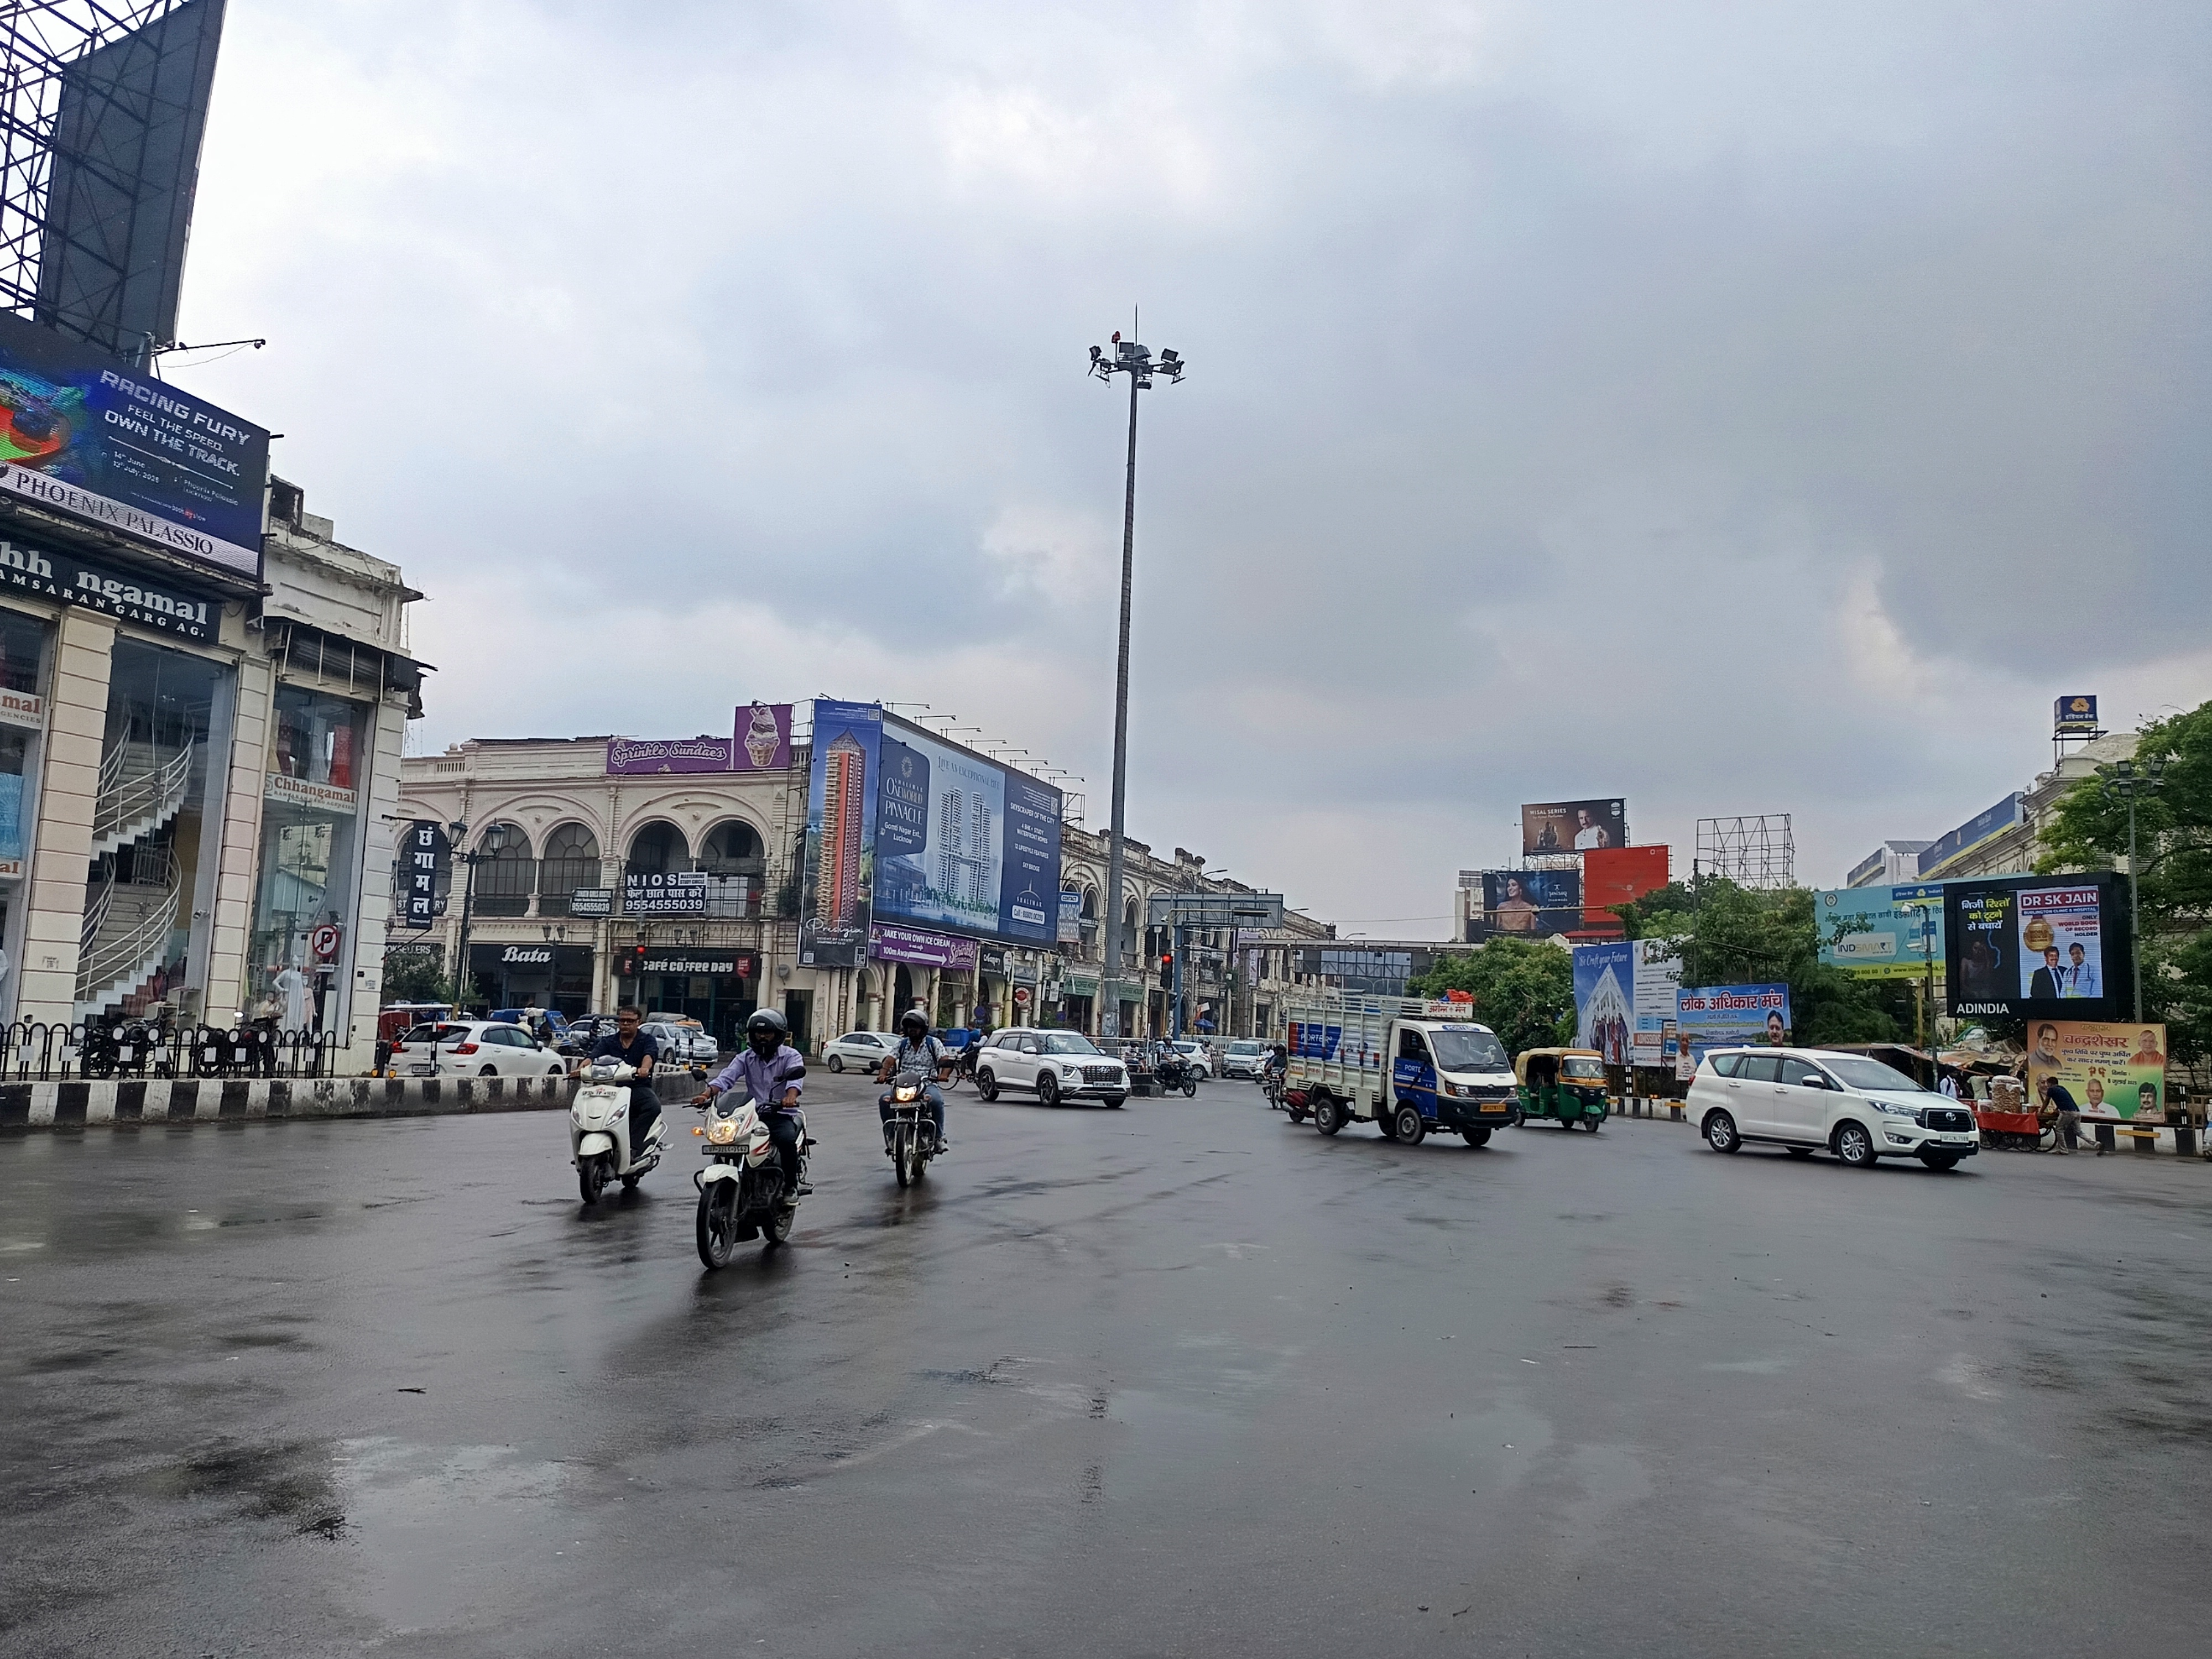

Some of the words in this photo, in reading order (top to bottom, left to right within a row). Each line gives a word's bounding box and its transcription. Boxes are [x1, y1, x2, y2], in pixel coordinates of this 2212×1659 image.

[100, 369, 189, 420] RACING
[193, 411, 251, 446] FURY
[128, 404, 155, 424] FEEL
[160, 417, 182, 435] THE
[105, 409, 149, 439] OWN
[153, 427, 184, 453] THE
[188, 443, 241, 477] TRACK.
[17, 471, 118, 522] PHOENIX
[127, 510, 213, 555] PALASSIO
[115, 604, 167, 626] GARG
[612, 742, 668, 768] Sprinkle
[669, 741, 727, 760] Sundaes
[274, 776, 355, 804] Chhangamal
[885, 800, 923, 825] PINNACLE
[1010, 802, 1034, 818] SKYSCRAPER
[1047, 816, 1055, 825] CITY
[884, 821, 899, 831] Gomti
[899, 826, 912, 836] Nagar
[893, 833, 912, 844] Lucknow
[1016, 828, 1037, 841] WATERFRONT
[1037, 834, 1048, 844] HOMES
[1034, 849, 1049, 859] FEATURES
[1029, 864, 1040, 873] BRIDGE
[626, 886, 644, 899] फेल
[667, 888, 686, 898] पास
[687, 886, 704, 898] करें
[2022, 896, 2041, 906] DR
[2044, 894, 2062, 905] SK
[2065, 892, 2096, 904] JAIN
[571, 902, 610, 912] 9554555039
[625, 899, 703, 911] 9554555039
[1016, 896, 1042, 907] SHALIMAR
[1961, 899, 1984, 910] निजी
[1985, 896, 2011, 909] रिश्तों
[1968, 911, 1981, 920] को
[1967, 921, 1976, 931] से
[1978, 920, 2004, 931] बचायें
[898, 931, 912, 941] YOUR
[912, 934, 925, 943] OWN
[925, 936, 933, 945] ICE
[933, 939, 951, 948] CREAM
[502, 946, 552, 963] Bata
[883, 946, 898, 956] 100m
[897, 948, 910, 959] Away
[1587, 953, 1598, 967] Craft
[1599, 956, 1610, 968] your
[1611, 951, 1627, 963] Future
[1681, 993, 1706, 1011] लोक
[1709, 990, 1759, 1011] अधिकार
[1760, 989, 1784, 1009] मंच
[1956, 1003, 2010, 1014] ADINDIA
[2063, 1034, 2130, 1048] चन्द्रशेखर
[1405, 1065, 1427, 1073] PORTE
